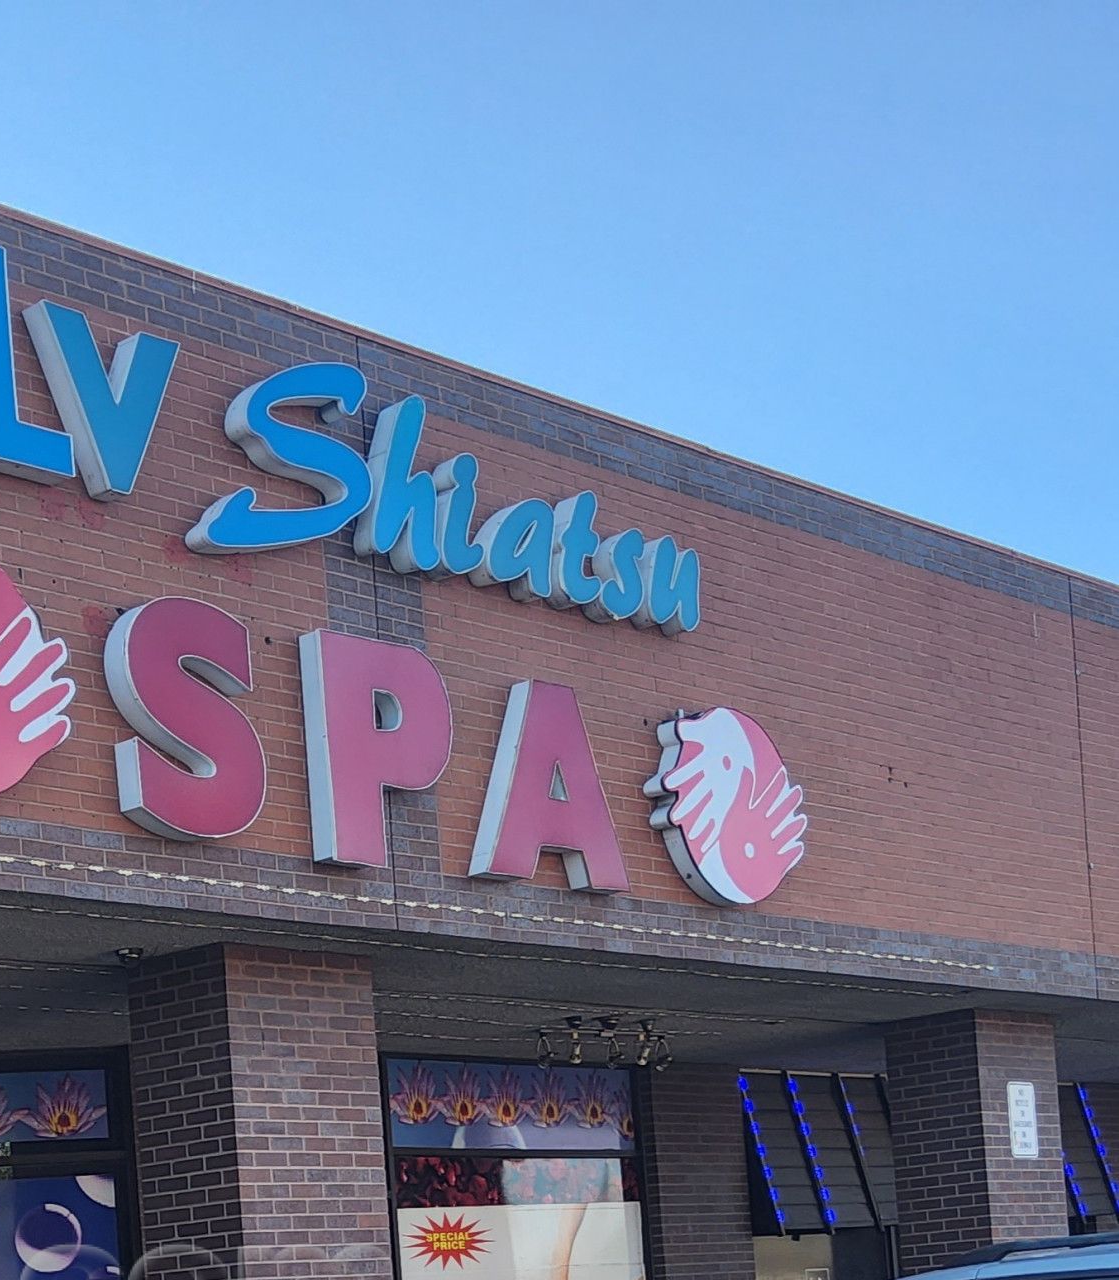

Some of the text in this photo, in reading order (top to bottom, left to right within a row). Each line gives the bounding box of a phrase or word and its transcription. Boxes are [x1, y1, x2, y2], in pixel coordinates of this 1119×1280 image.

[185, 361, 700, 636] Shiatsu
[104, 595, 631, 893] SPA
[425, 1231, 471, 1242] SPECIAL
[433, 1241, 466, 1251] PRICE
